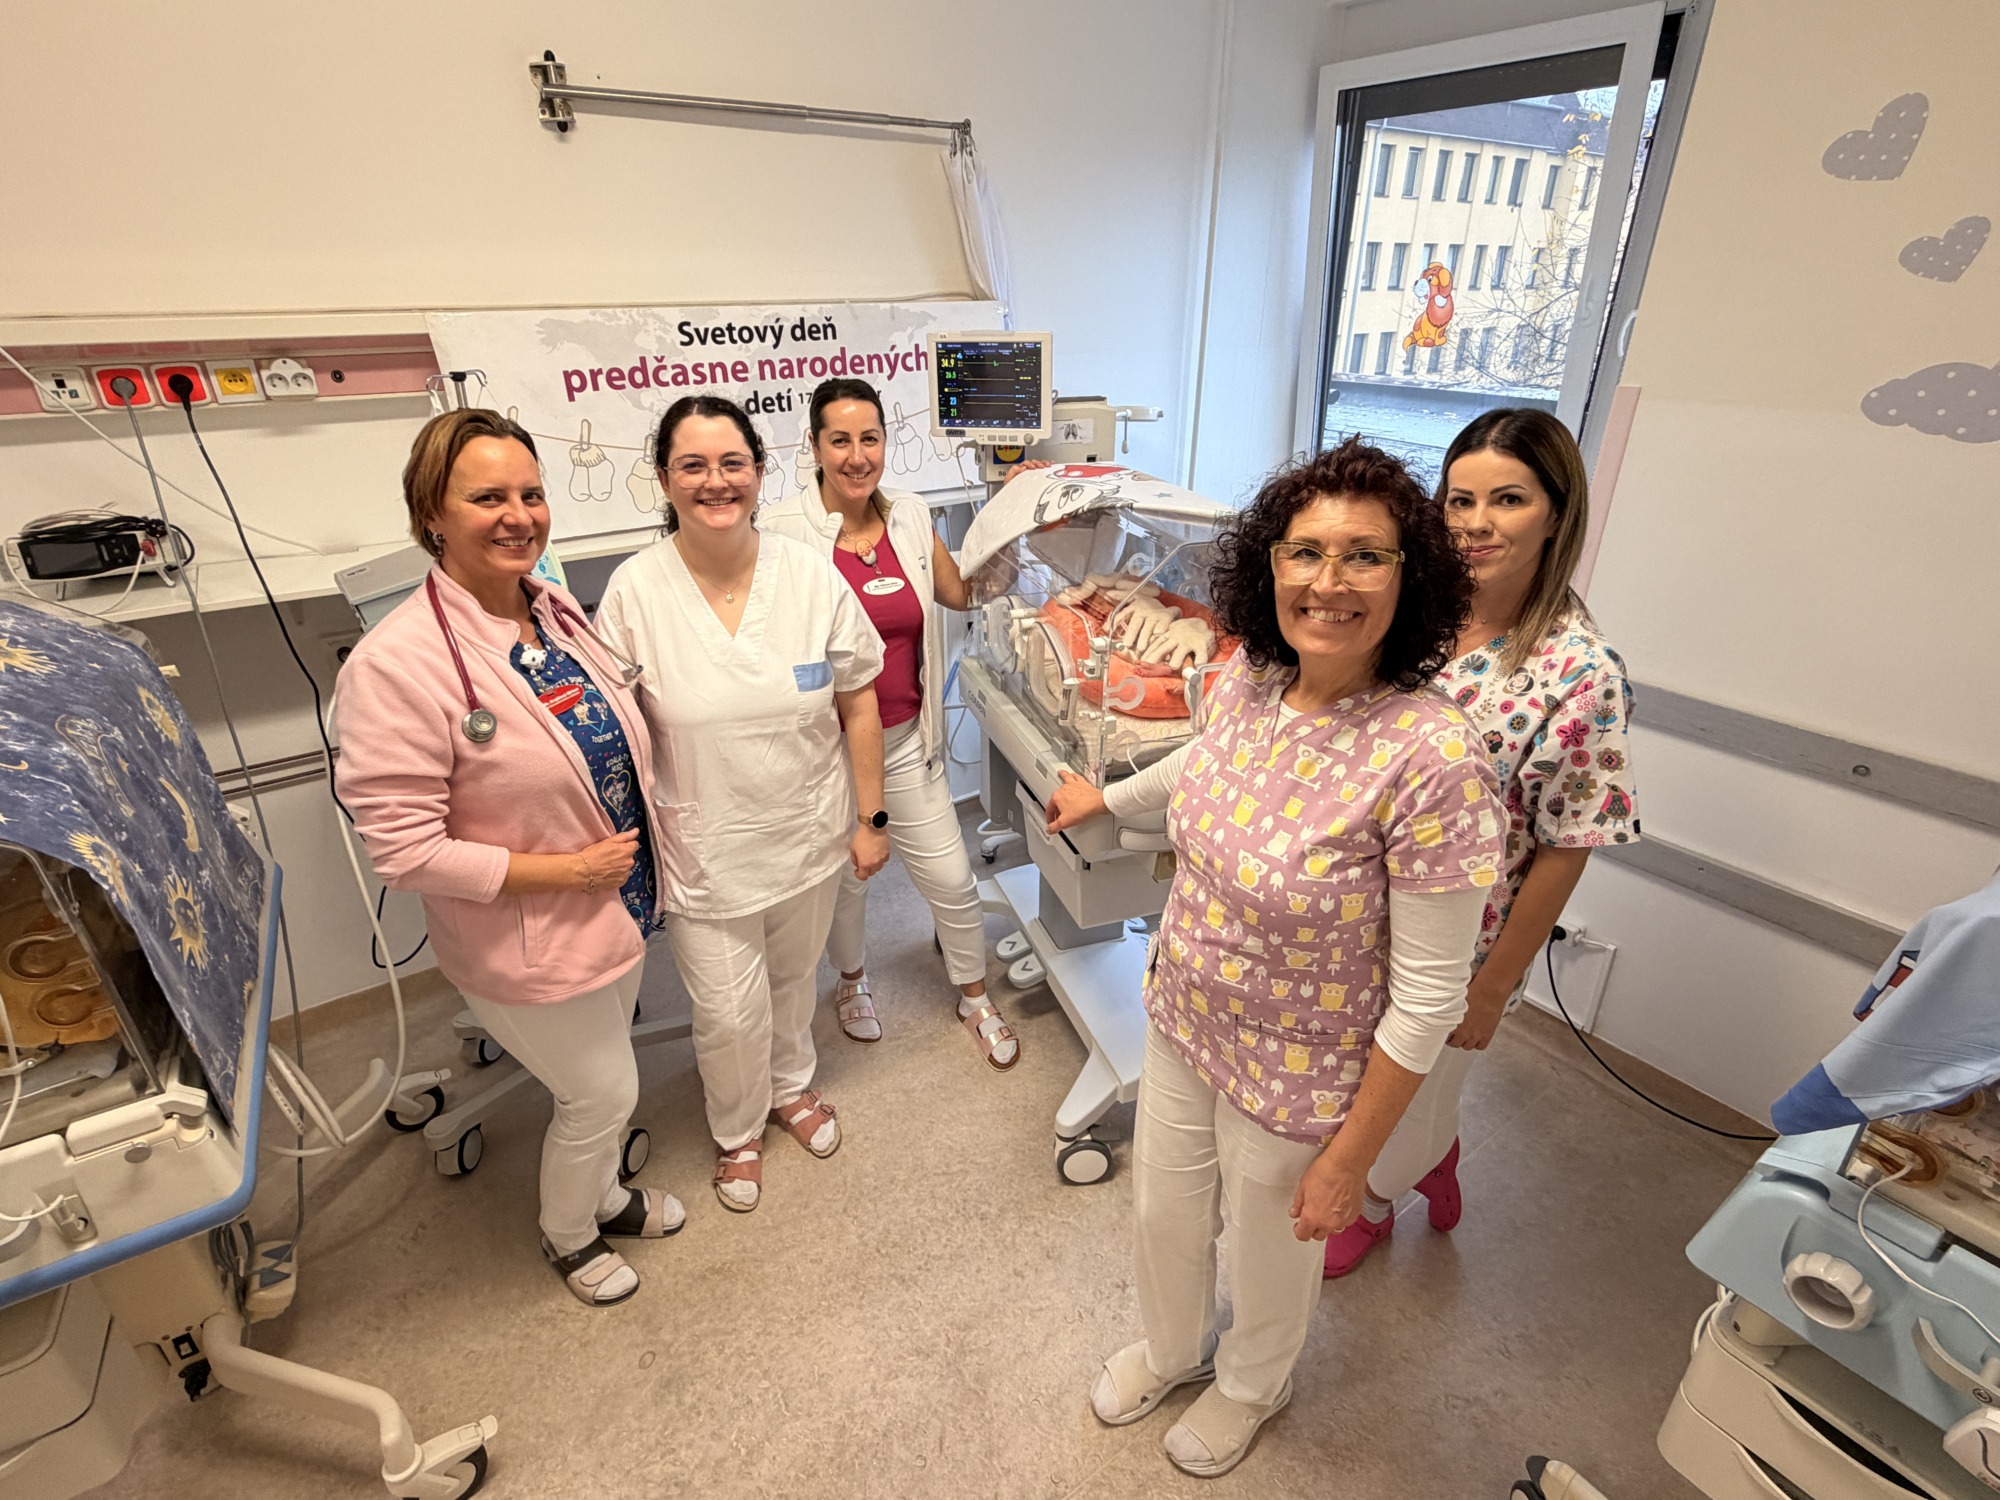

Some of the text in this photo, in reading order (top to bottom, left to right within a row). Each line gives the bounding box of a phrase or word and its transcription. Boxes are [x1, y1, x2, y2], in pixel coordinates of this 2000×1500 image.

[678, 316, 837, 350] Svetový deň
[562, 343, 929, 402] predčasne narodených
[744, 388, 793, 415] detí
